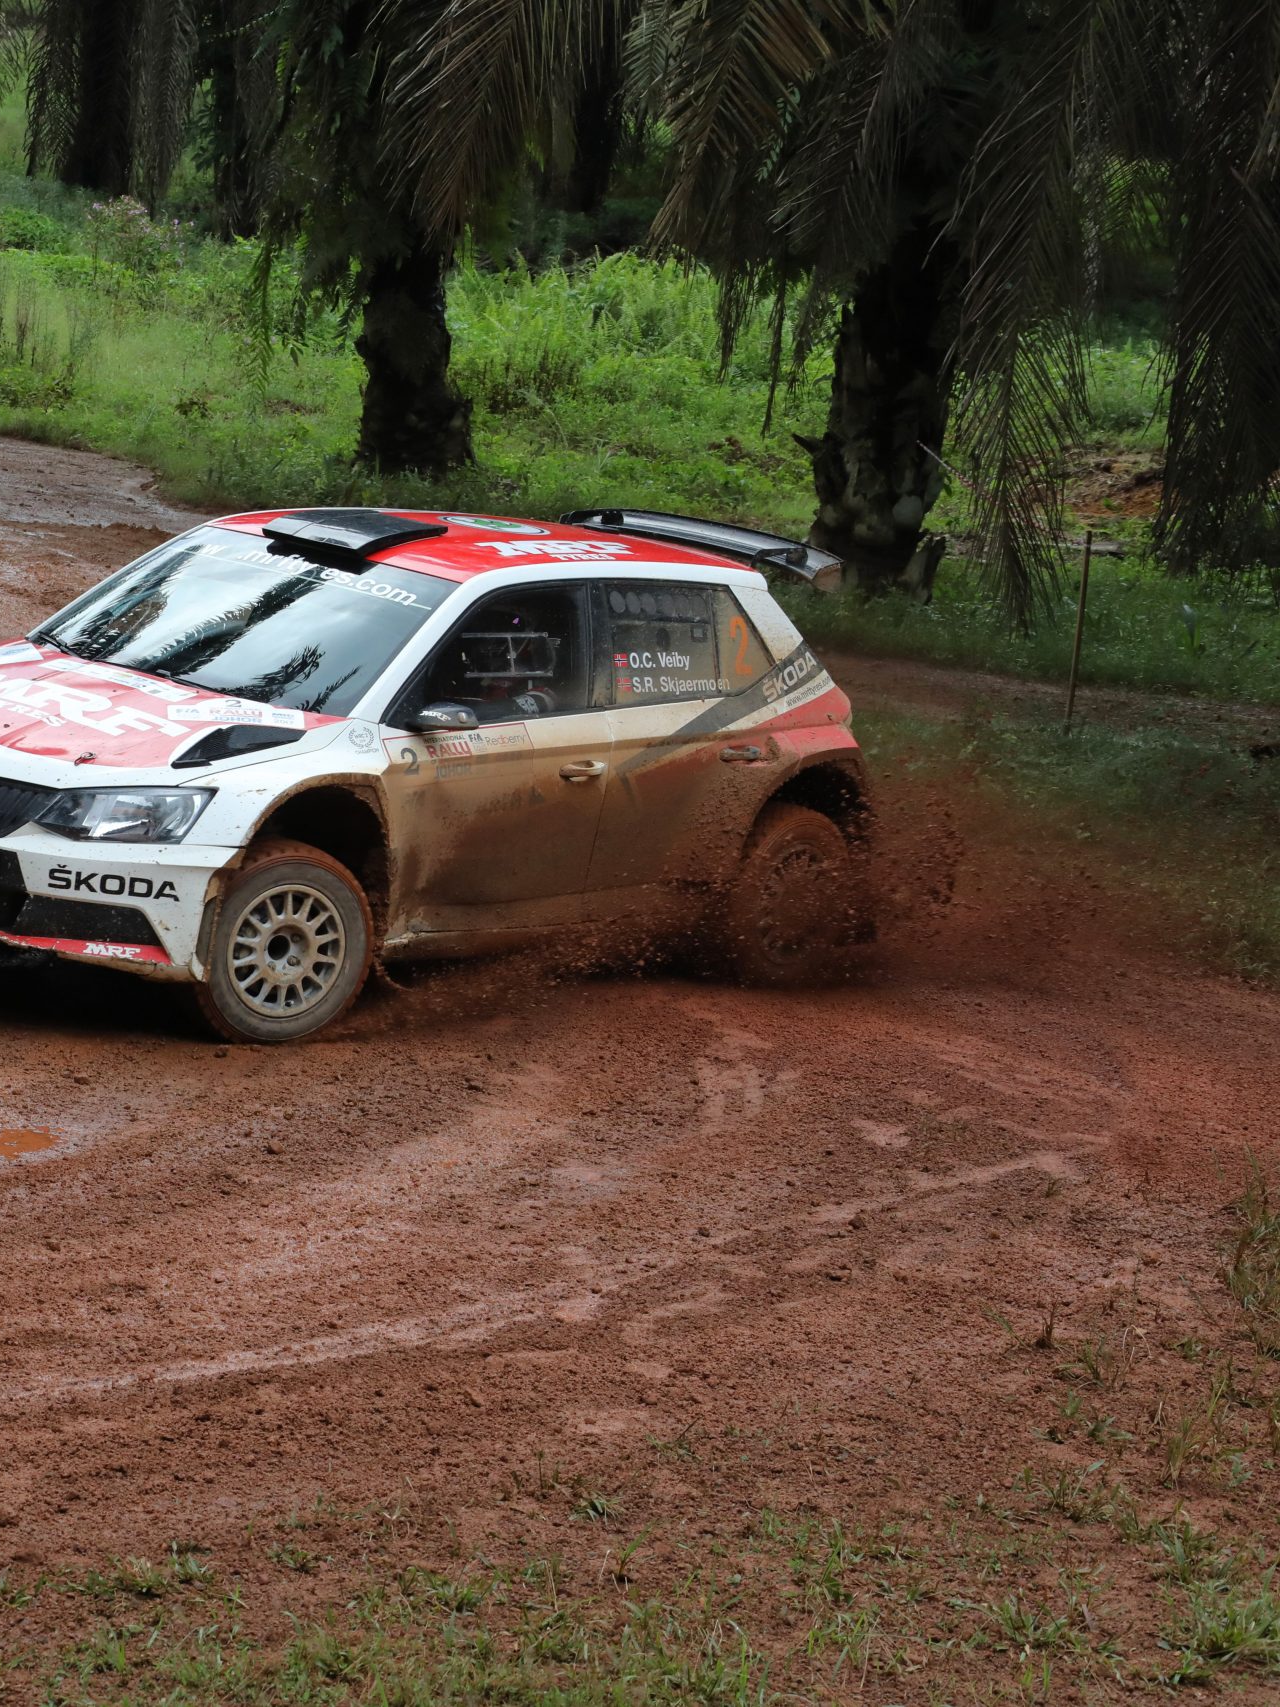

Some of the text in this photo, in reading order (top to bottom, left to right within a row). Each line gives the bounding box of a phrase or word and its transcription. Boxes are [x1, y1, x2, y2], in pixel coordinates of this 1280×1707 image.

[474, 540, 635, 556] MRF
[550, 553, 616, 561] TYRES
[729, 615, 753, 676] 2
[629, 652, 690, 671] O.C. Veiby
[632, 676, 657, 694] S.R.
[762, 651, 817, 703] ŠKODA
[225, 699, 242, 708] 2
[400, 747, 420, 776] 2
[48, 863, 180, 902] ŠKODA
[83, 942, 141, 958] MRF
